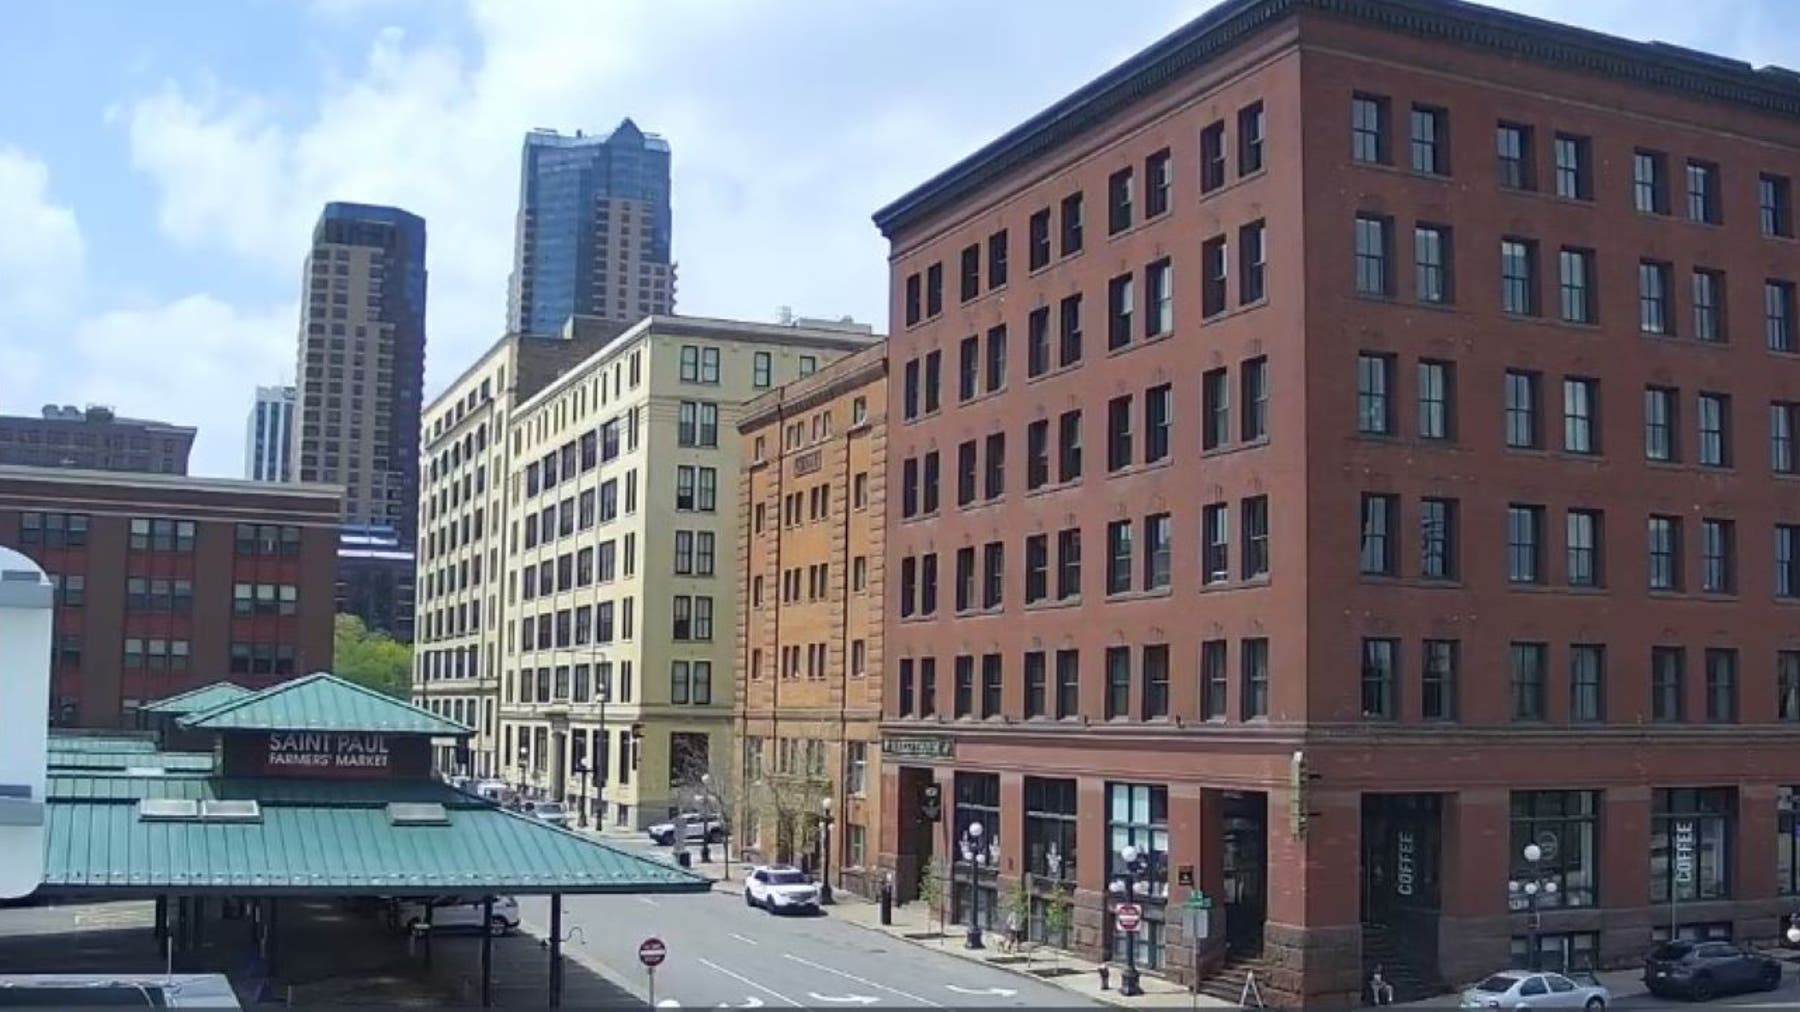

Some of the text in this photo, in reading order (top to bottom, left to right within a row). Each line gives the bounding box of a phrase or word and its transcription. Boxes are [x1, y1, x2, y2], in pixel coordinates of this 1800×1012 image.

[269, 733, 389, 753] SAINT PAUL
[335, 753, 388, 767] MARKET
[1397, 831, 1413, 895] COFFEE
[1675, 822, 1692, 882] COFFEE
